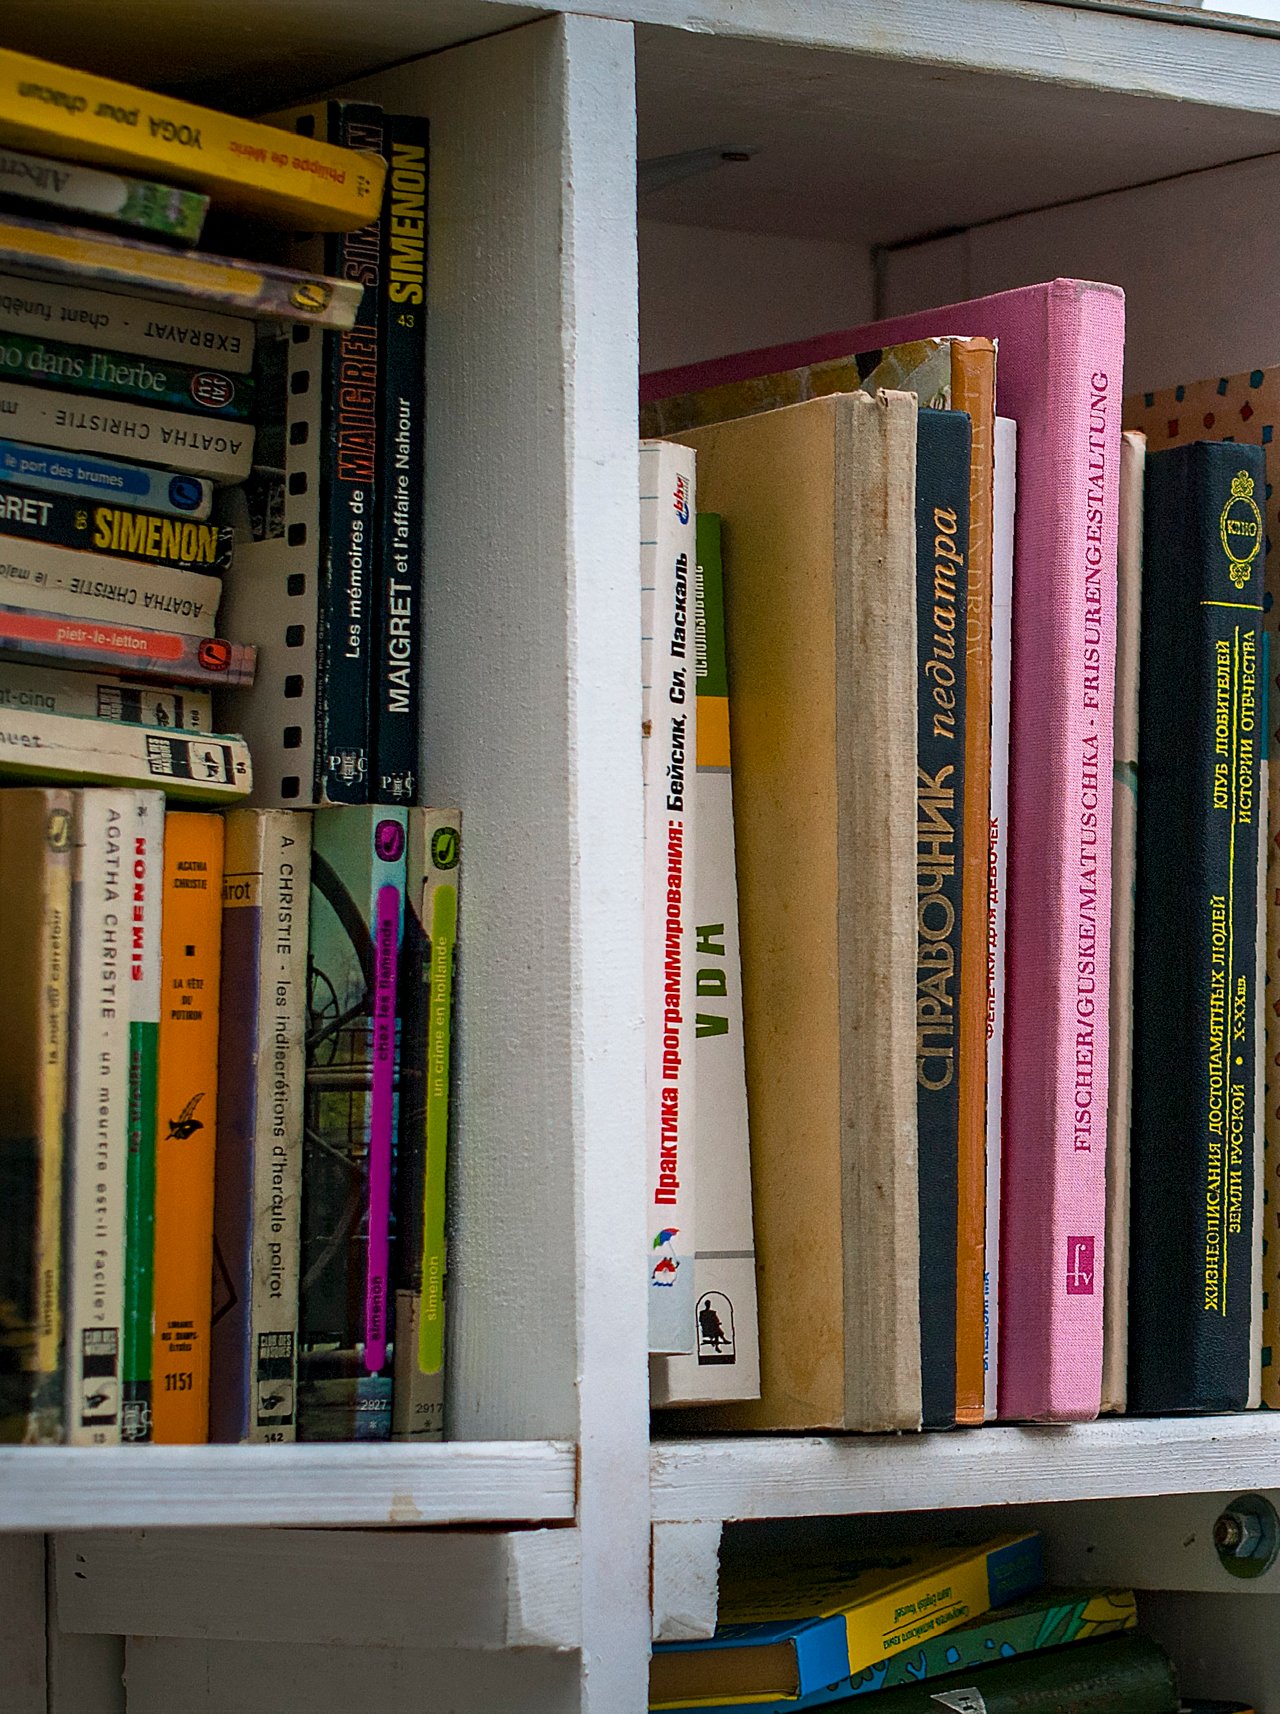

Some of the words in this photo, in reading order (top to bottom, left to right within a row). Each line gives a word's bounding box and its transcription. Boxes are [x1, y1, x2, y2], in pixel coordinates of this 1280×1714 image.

[16, 81, 89, 116] chacun
[99, 102, 139, 128] pour
[148, 116, 203, 149] YOGA
[270, 150, 290, 169] de
[292, 153, 347, 184] Philippe
[389, 144, 427, 305] SIMENON
[61, 308, 110, 328] chant
[144, 321, 241, 353] EXBRAYAT
[397, 313, 416, 328] 43
[25, 342, 84, 379] dans
[88, 345, 169, 393] l'herbe
[56, 409, 151, 440] CHRISTIE
[160, 427, 243, 456] AGATHA
[397, 396, 412, 469] Nahour
[4, 453, 17, 468] le
[20, 458, 48, 474] port
[50, 463, 74, 479] des
[78, 466, 125, 488] brumes
[347, 489, 365, 514] de
[393, 475, 410, 550] l'affaire
[94, 507, 220, 564] SIMENON
[1082, 371, 1109, 713] FRISURENGESTALTUNG
[35, 571, 48, 587] le
[346, 519, 364, 619] mémoires
[393, 553, 409, 574] et
[70, 577, 138, 606] CHRISTIE
[144, 591, 204, 619] AGATHA
[670, 552, 688, 659] Паскаль
[57, 625, 148, 651] pietr-le-letton
[345, 623, 362, 659] Les
[387, 577, 412, 713] MAIGRET
[925, 506, 965, 740] педиатра
[669, 666, 688, 705] Си,
[1214, 639, 1231, 759] ЛЮБИТЕЛЕЙ
[1239, 629, 1256, 732] ОТЕЧЕСТВА
[666, 713, 688, 812] Бейсик,
[1213, 762, 1229, 811] КЛУБ
[1238, 738, 1254, 824] ИСТОРИИ
[104, 808, 122, 902] AGATHA
[177, 861, 208, 872] AGATHA
[280, 835, 296, 855] A.
[173, 878, 208, 889] CHRISTIE
[277, 863, 294, 955] CHRISTIE
[131, 837, 147, 982] SIMENON
[915, 764, 956, 1091] СПРАВОЧНИК
[1210, 893, 1226, 966] ЛЮДЕЙ
[101, 913, 119, 1020] CHRISTIE
[662, 820, 685, 1081] программирования:
[1073, 734, 1100, 1153] FISCHER/GUSKE/MATUSCHKA
[173, 978, 183, 989] LA
[276, 980, 291, 1006] les
[434, 936, 448, 1003] hollande
[377, 995, 391, 1019] les
[434, 1007, 447, 1027] en
[100, 1051, 112, 1076] un
[376, 1025, 391, 1062] chez
[432, 1030, 446, 1074] crime
[1206, 968, 1226, 1138] ДОСТОПАМЯТНЫХ
[272, 1015, 290, 1137] indiscrétions
[433, 1078, 445, 1098] un
[95, 1086, 111, 1171] meurtre
[654, 1087, 680, 1206] Практика
[1229, 1082, 1246, 1166] РУССКОЙ
[94, 1182, 109, 1238] est-il
[270, 1145, 287, 1233] d'hercule
[1228, 1168, 1243, 1234] ЗЕМЛИ
[1203, 1142, 1223, 1311] ЖИЗНЕОПИСАНИЯ
[268, 1242, 284, 1300] poirot
[426, 1255, 440, 1322] simenon
[370, 1275, 382, 1341] simenon
[165, 1372, 193, 1392] 1151
[360, 1399, 388, 1410] 2927
[415, 1402, 443, 1414] 2917
